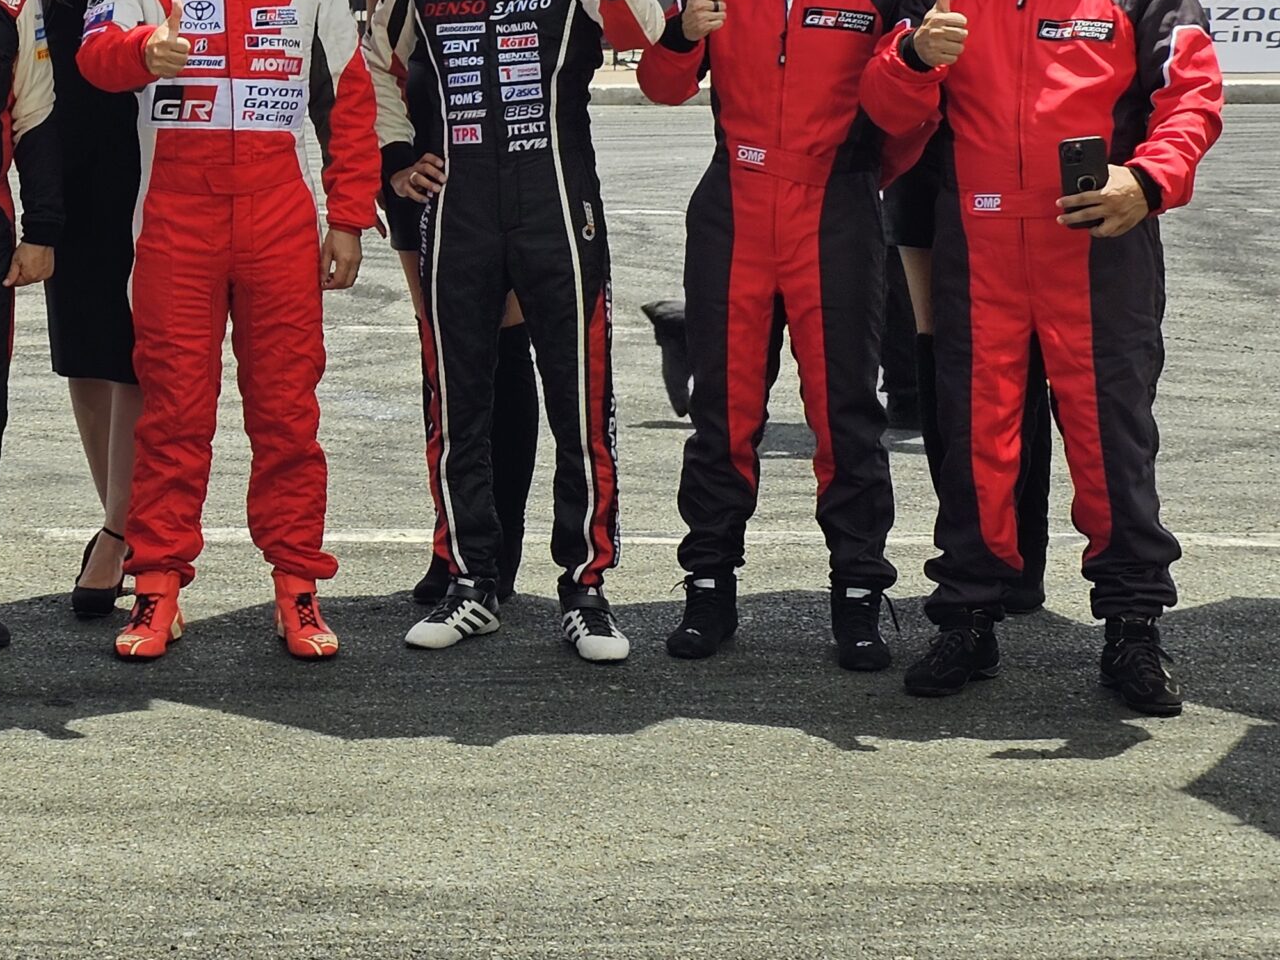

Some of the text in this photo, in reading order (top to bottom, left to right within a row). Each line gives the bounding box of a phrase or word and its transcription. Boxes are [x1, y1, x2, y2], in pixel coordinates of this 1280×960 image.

[424, 0, 487, 17] DENSO
[805, 14, 836, 27] GR
[839, 11, 874, 21] TOYOTA
[180, 21, 221, 31] TOYOTA
[1073, 26, 1109, 35] GAZOO
[1075, 20, 1113, 29] TOYOTA
[1041, 25, 1073, 39] GR
[1211, 25, 1280, 49] cing
[260, 37, 301, 48] PETRON
[443, 39, 480, 54] ZENT
[449, 56, 484, 68] ENEOS
[498, 51, 539, 60] GENTEX
[250, 57, 299, 73] MOTUL
[246, 85, 303, 98] TOYOTA
[450, 91, 483, 106] TOM'S
[153, 99, 214, 121] GR
[243, 98, 298, 111] GAZOO
[504, 103, 544, 120] BBS
[241, 110, 294, 126] Racing
[454, 127, 479, 142] TPR
[507, 121, 546, 137] JTEKT
[737, 148, 766, 163] OMP
[974, 195, 1001, 209] OMP
